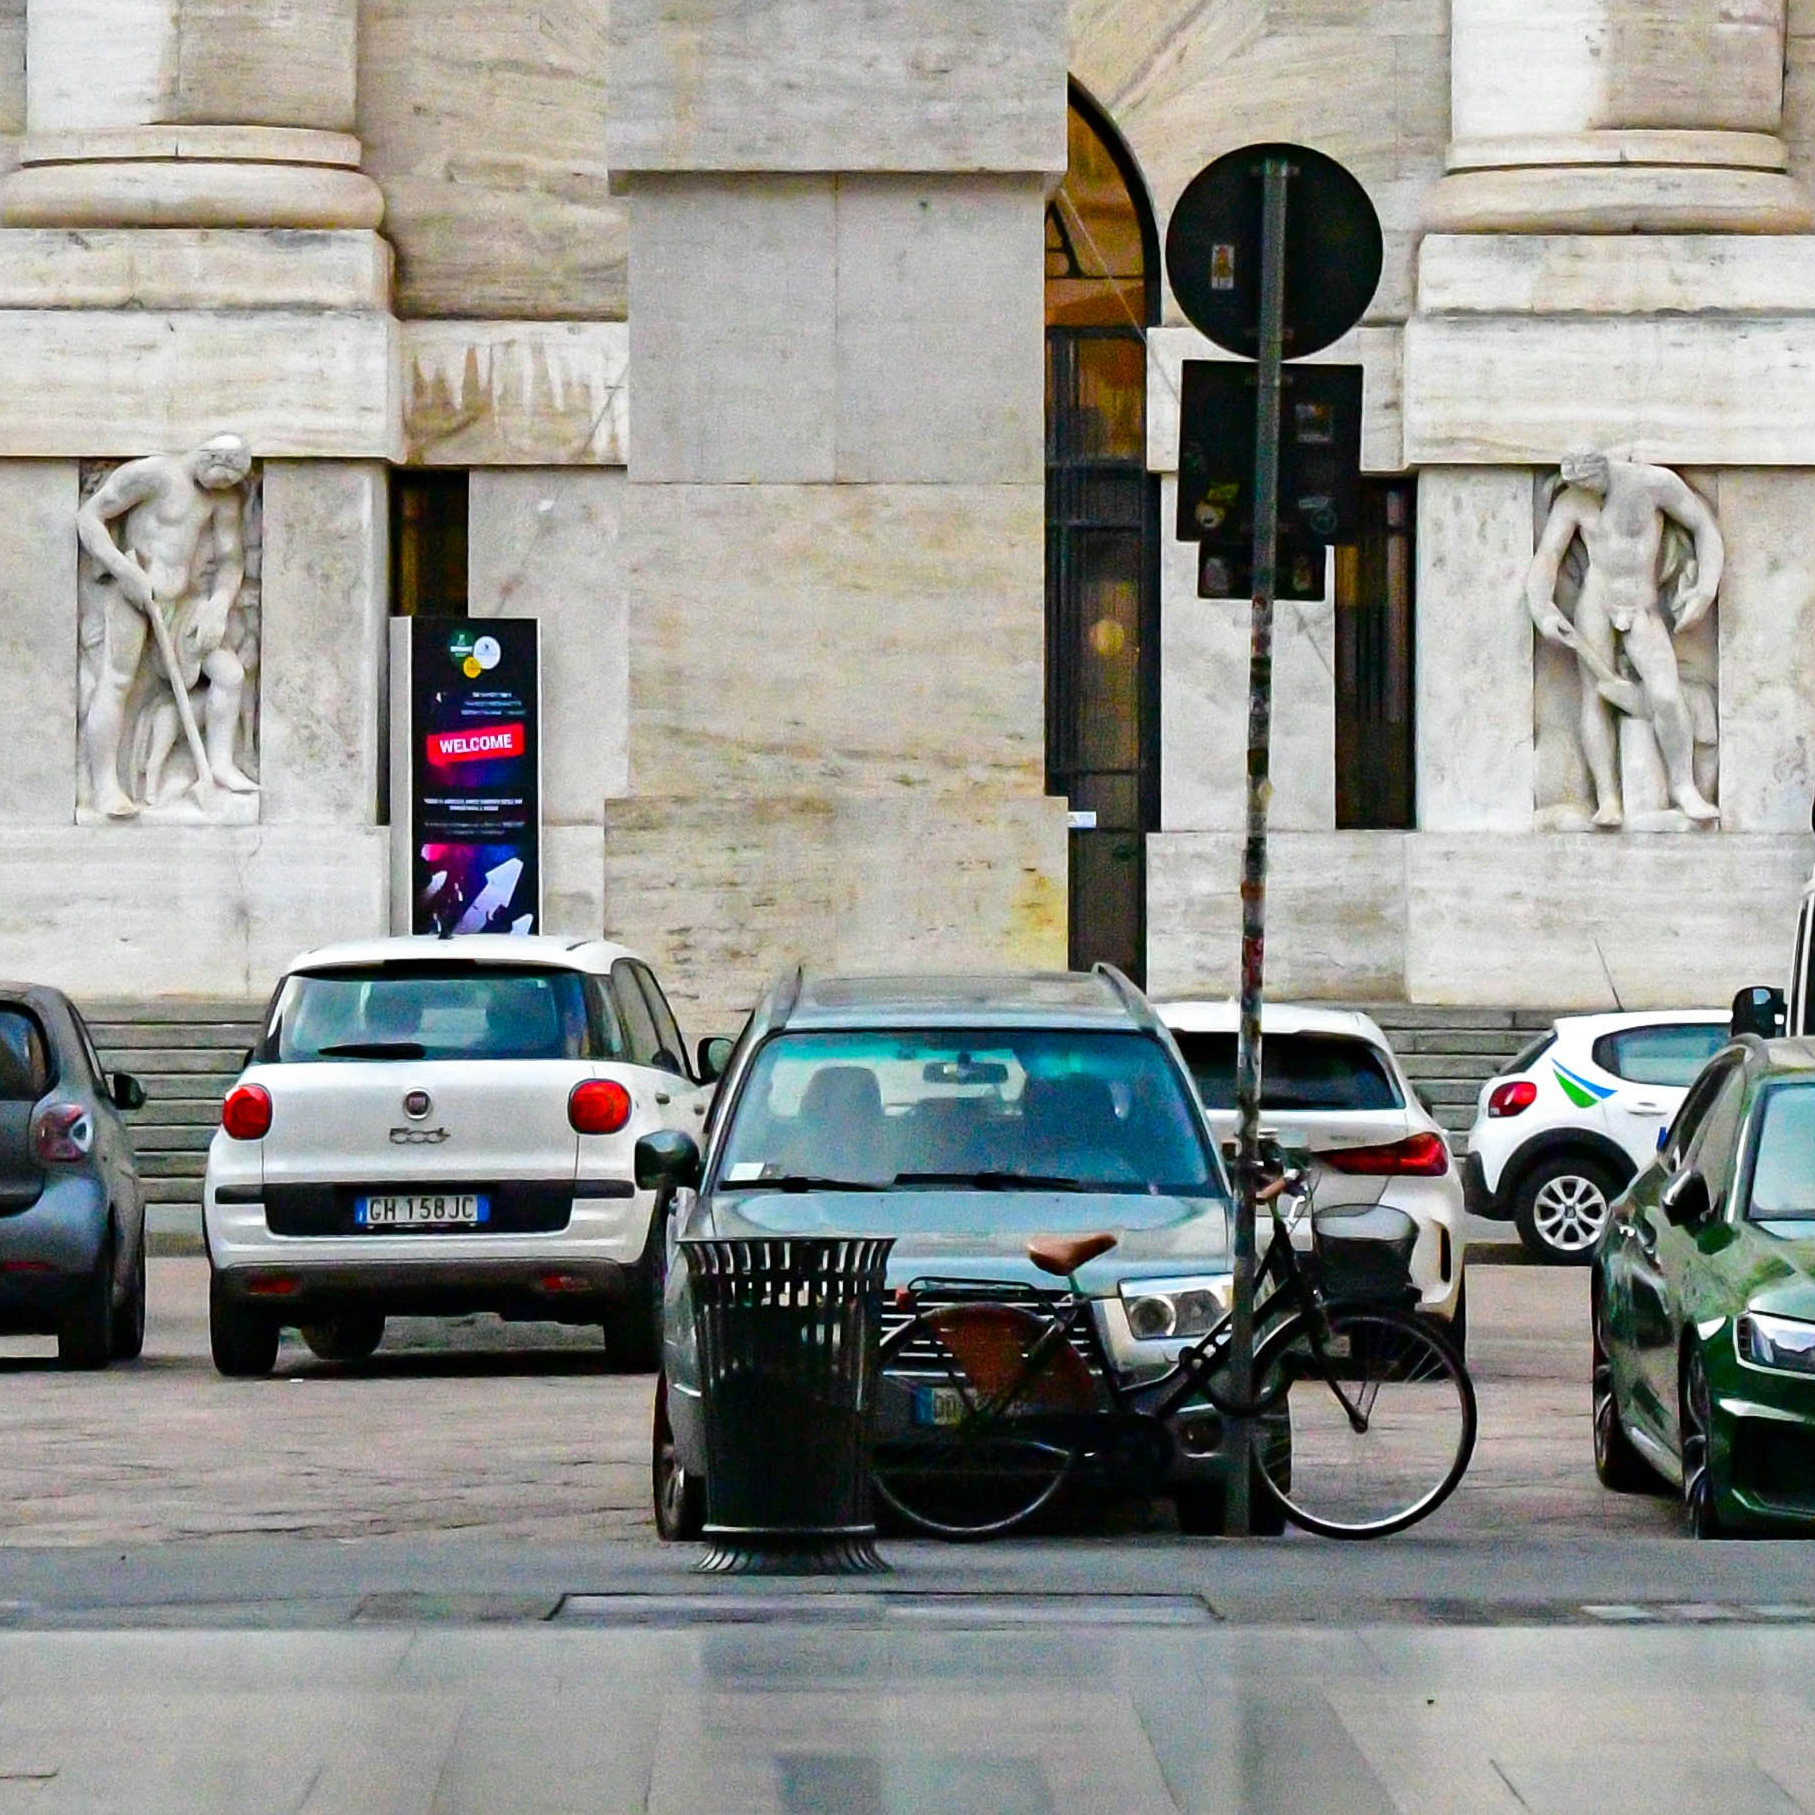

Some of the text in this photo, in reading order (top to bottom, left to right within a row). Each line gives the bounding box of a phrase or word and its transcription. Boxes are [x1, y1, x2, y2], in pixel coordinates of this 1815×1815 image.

[439, 733, 513, 755] WELCOME
[369, 1196, 475, 1221] GH 158JC
